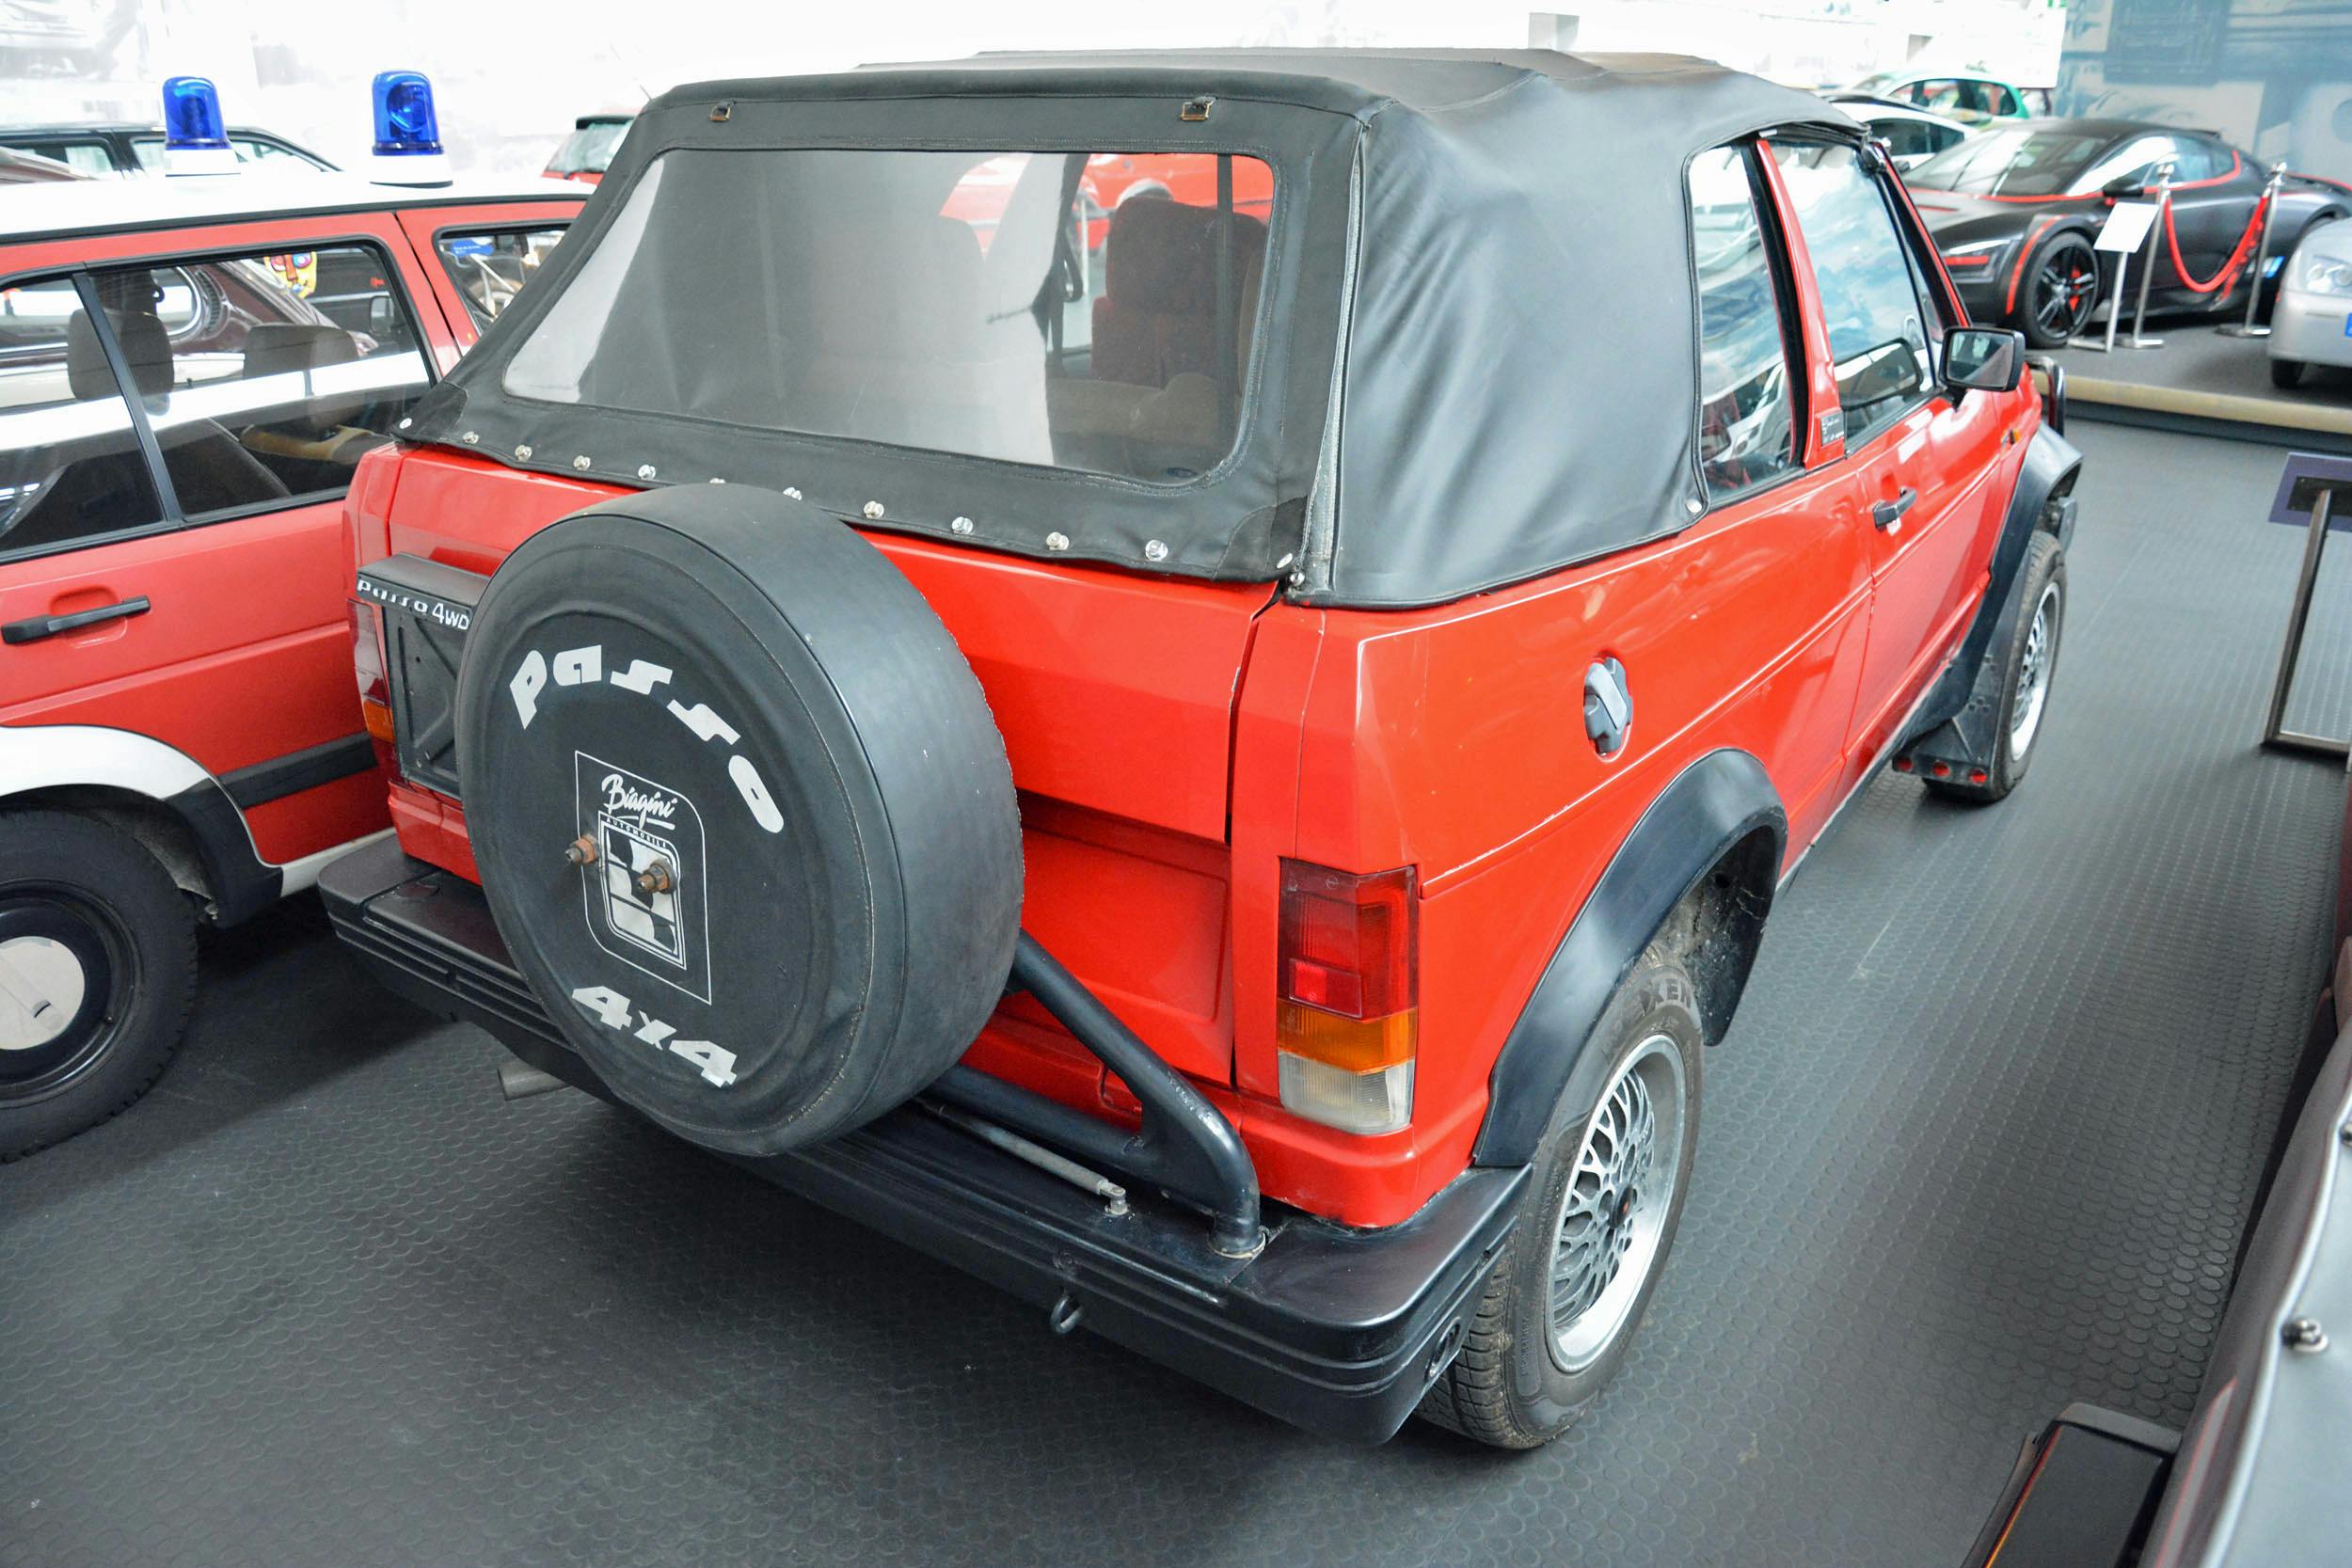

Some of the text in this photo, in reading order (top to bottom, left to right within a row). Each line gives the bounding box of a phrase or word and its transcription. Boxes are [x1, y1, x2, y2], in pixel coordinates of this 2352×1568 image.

[432, 602, 469, 630] 4WD
[601, 773, 678, 830] Biagini
[572, 986, 738, 1088] 4x4
